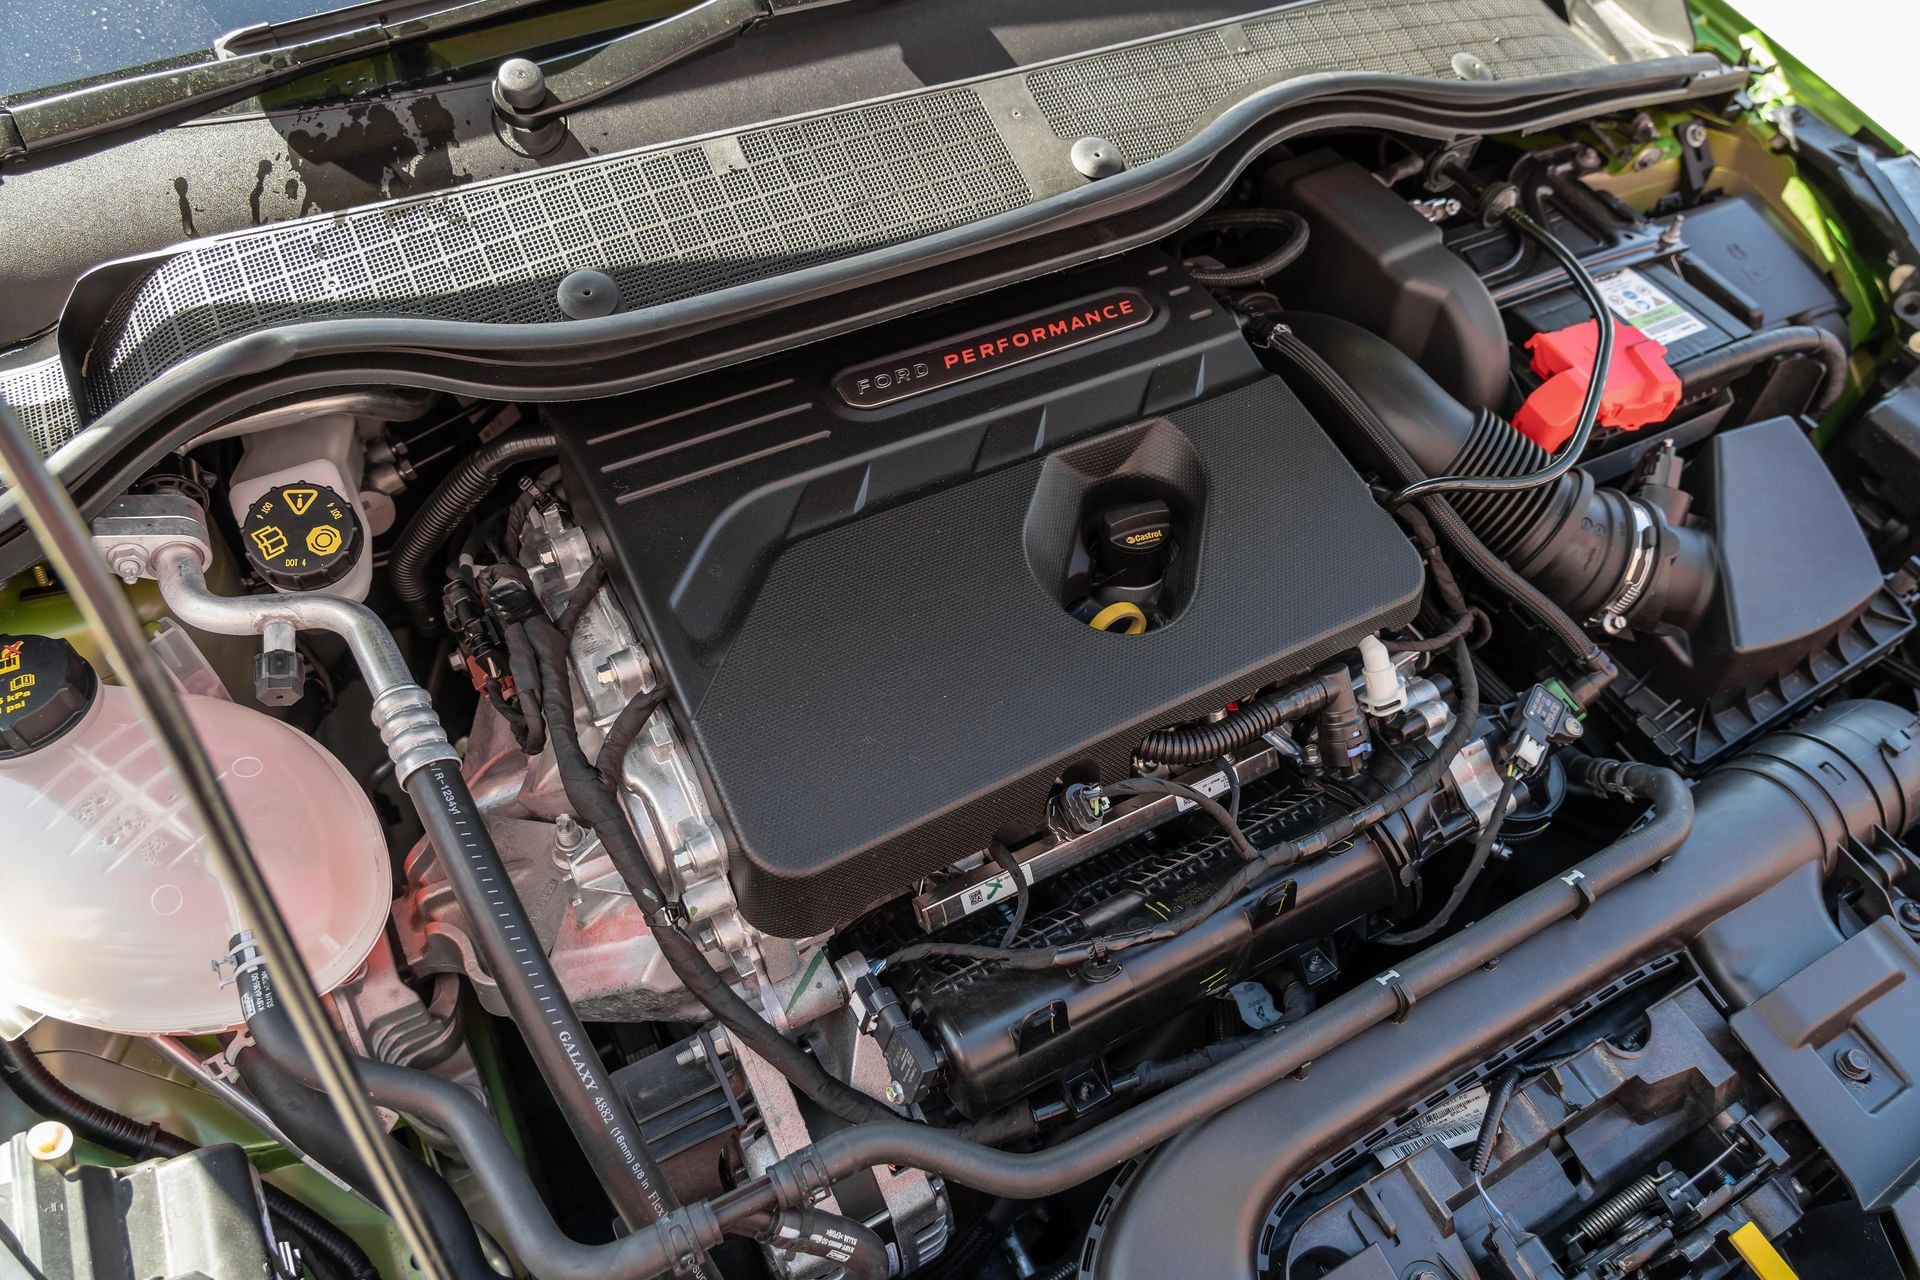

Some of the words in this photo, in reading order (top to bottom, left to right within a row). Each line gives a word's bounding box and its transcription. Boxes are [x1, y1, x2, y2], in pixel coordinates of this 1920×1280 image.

[857, 362, 930, 395] FORD
[943, 299, 1135, 370] PERFORMANCE
[1134, 529, 1163, 542] Castrol
[285, 558, 299, 567] DOT
[301, 558, 307, 567] 4
[6, 690, 31, 702] kPa
[6, 700, 26, 714] psi
[559, 1030, 599, 1090] GALAXY
[594, 1096, 615, 1125] 4882
[610, 1126, 636, 1164] (16mm)
[631, 1162, 646, 1181] 5/8
